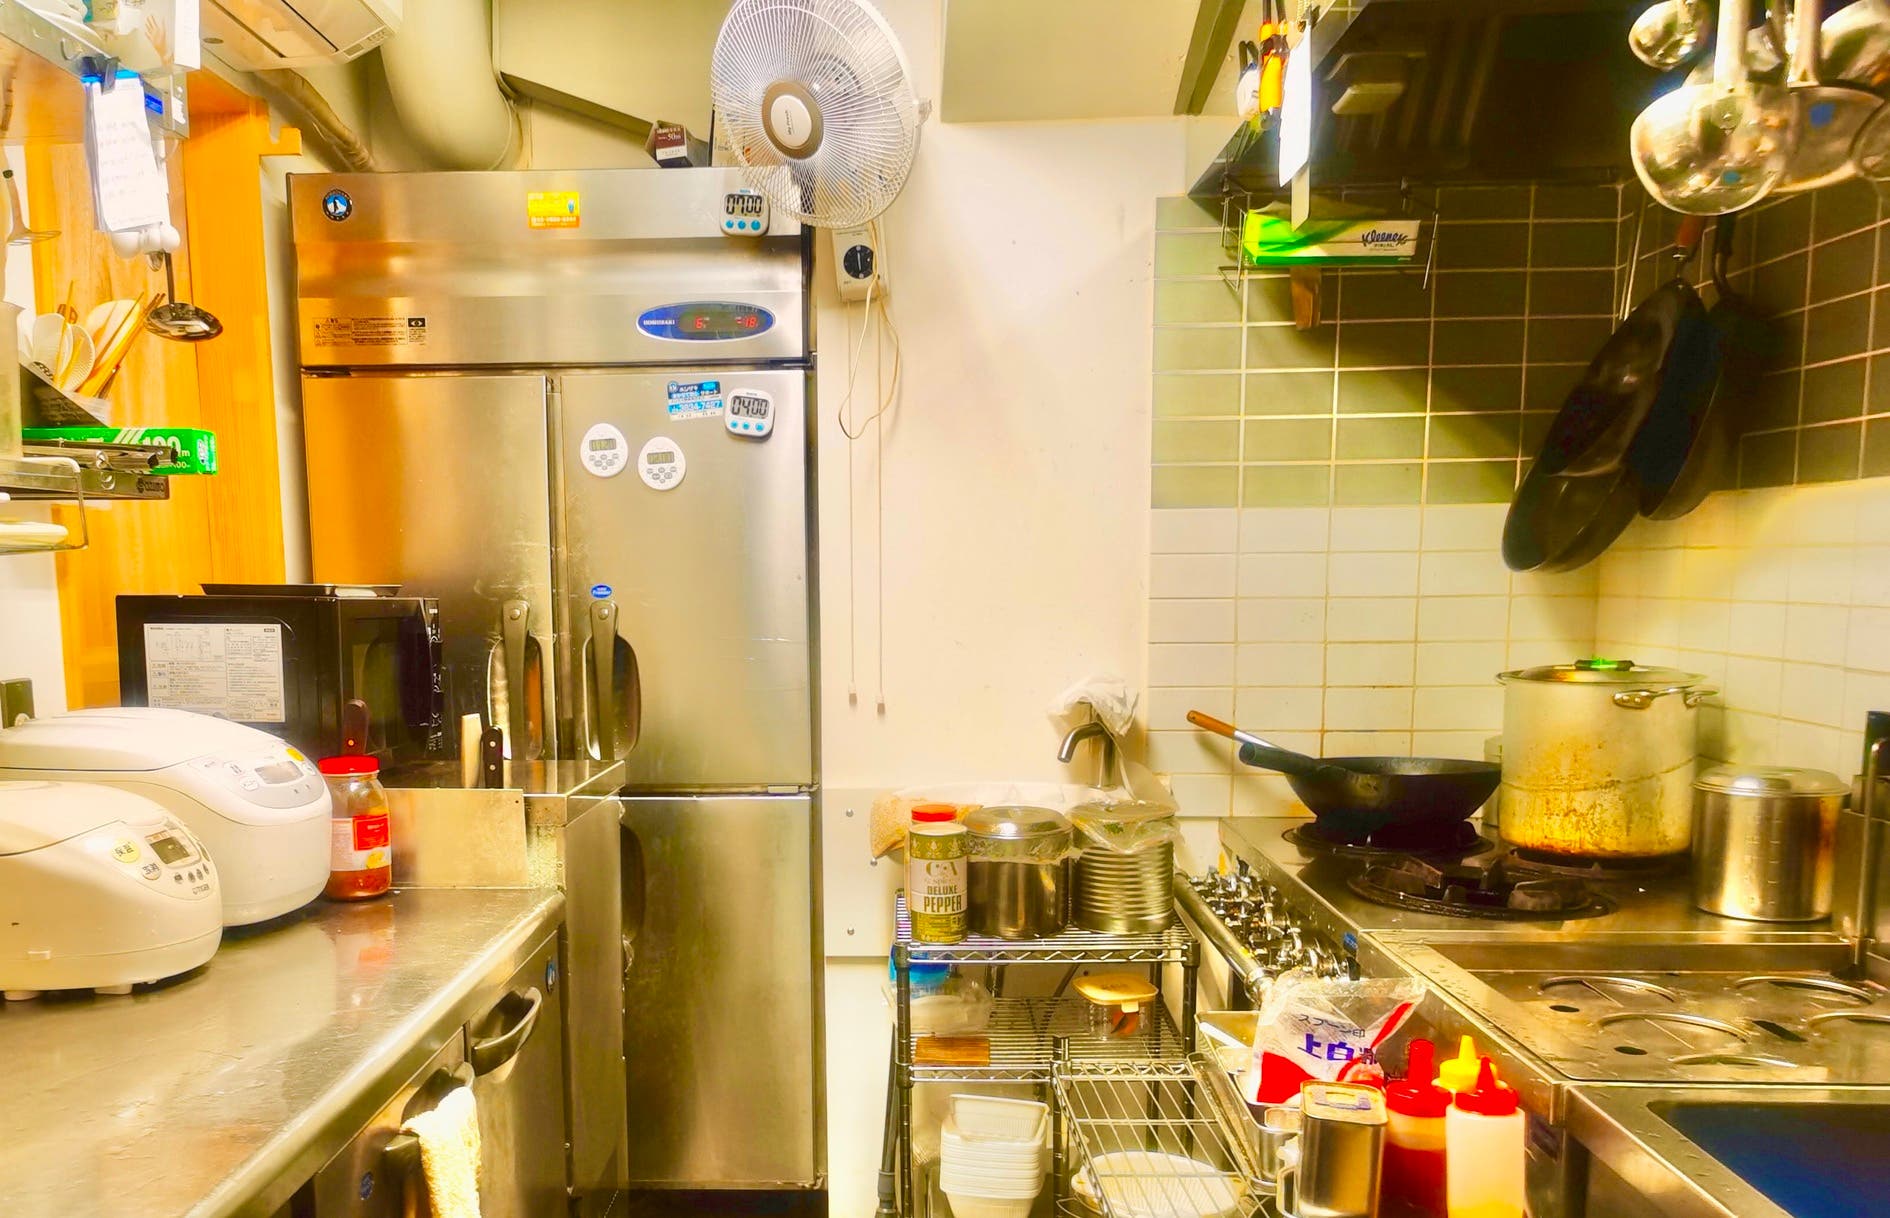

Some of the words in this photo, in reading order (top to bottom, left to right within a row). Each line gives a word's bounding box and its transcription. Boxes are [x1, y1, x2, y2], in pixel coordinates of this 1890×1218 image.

[1362, 229, 1408, 247] Kleenex
[927, 885, 958, 895] DELUXE
[924, 895, 962, 912] PEPPER
